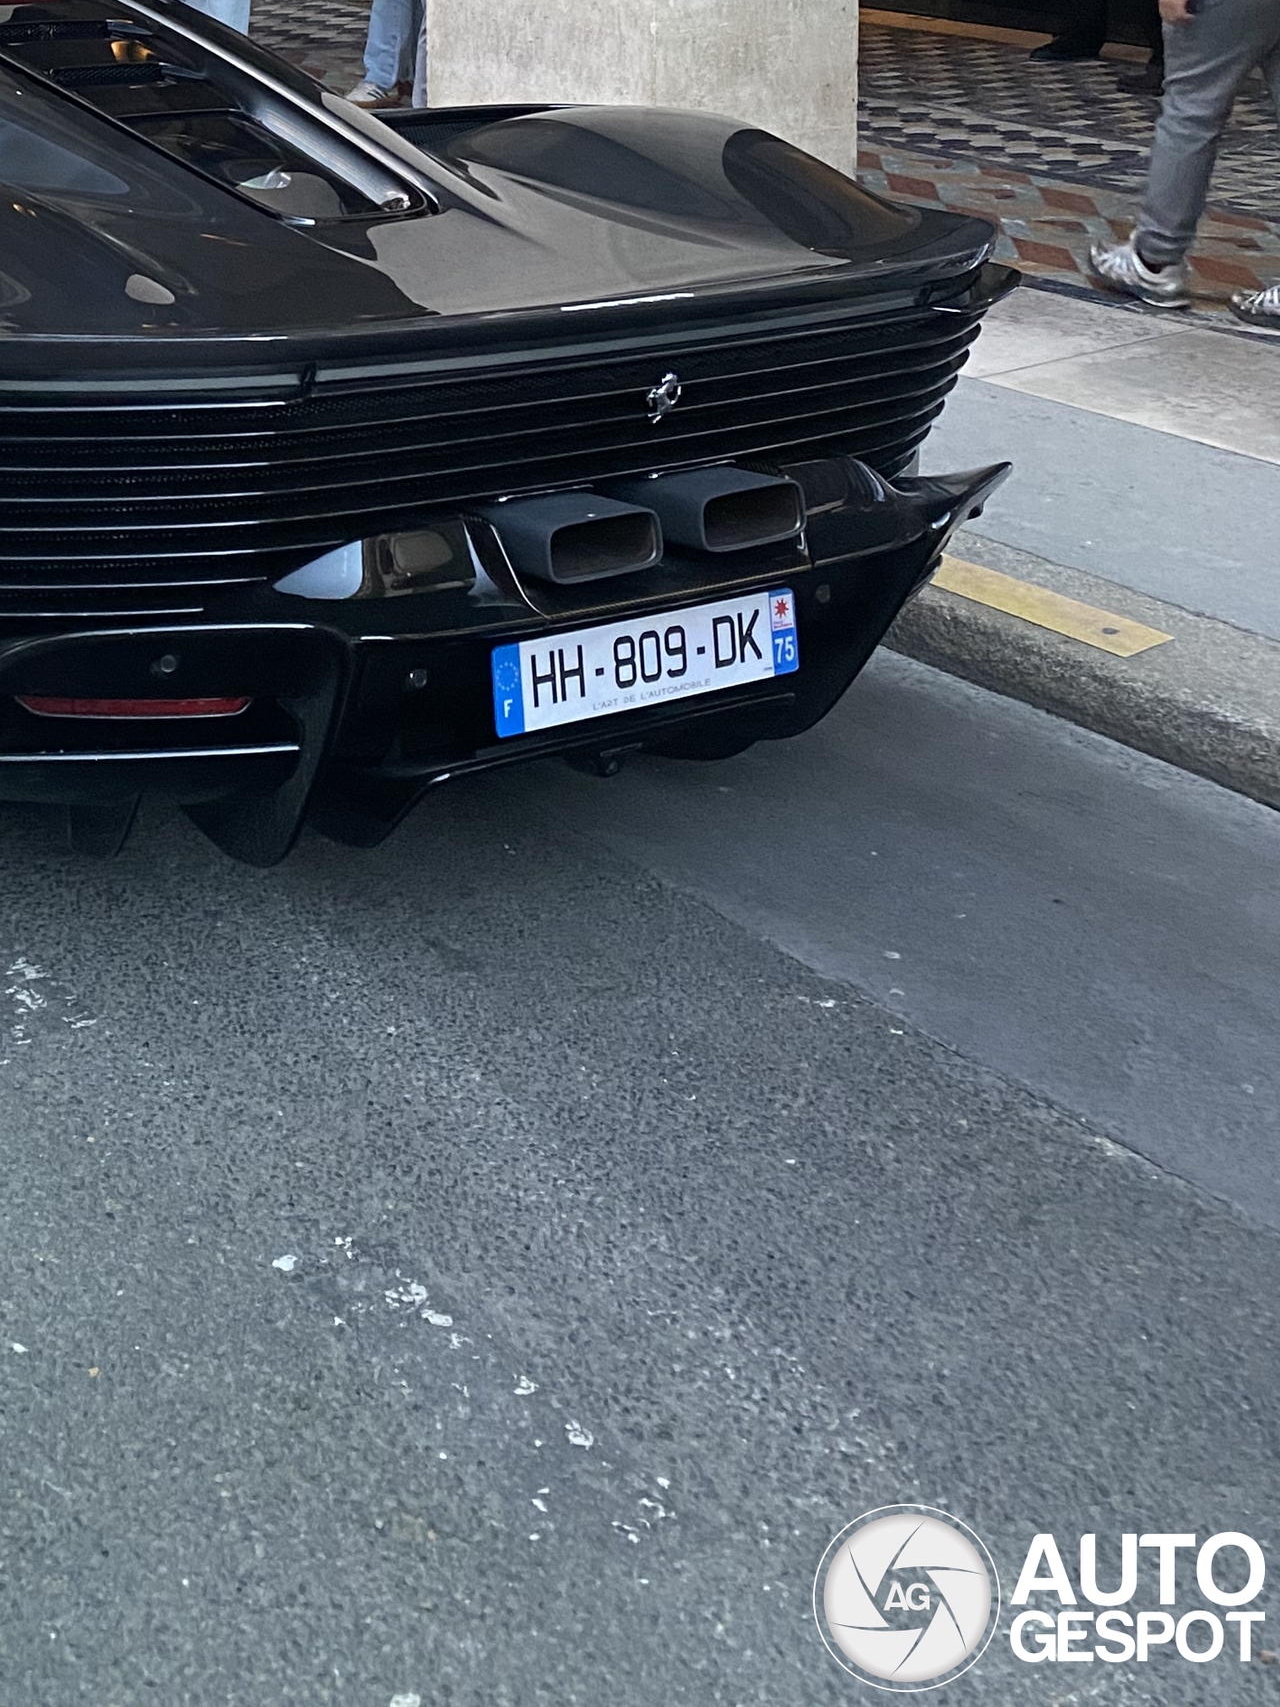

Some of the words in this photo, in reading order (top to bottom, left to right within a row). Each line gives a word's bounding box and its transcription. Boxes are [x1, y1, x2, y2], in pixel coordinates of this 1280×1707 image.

[530, 609, 763, 708] HH-809-DK
[774, 635, 795, 664] 75
[502, 699, 514, 719] F
[623, 694, 637, 705] DE
